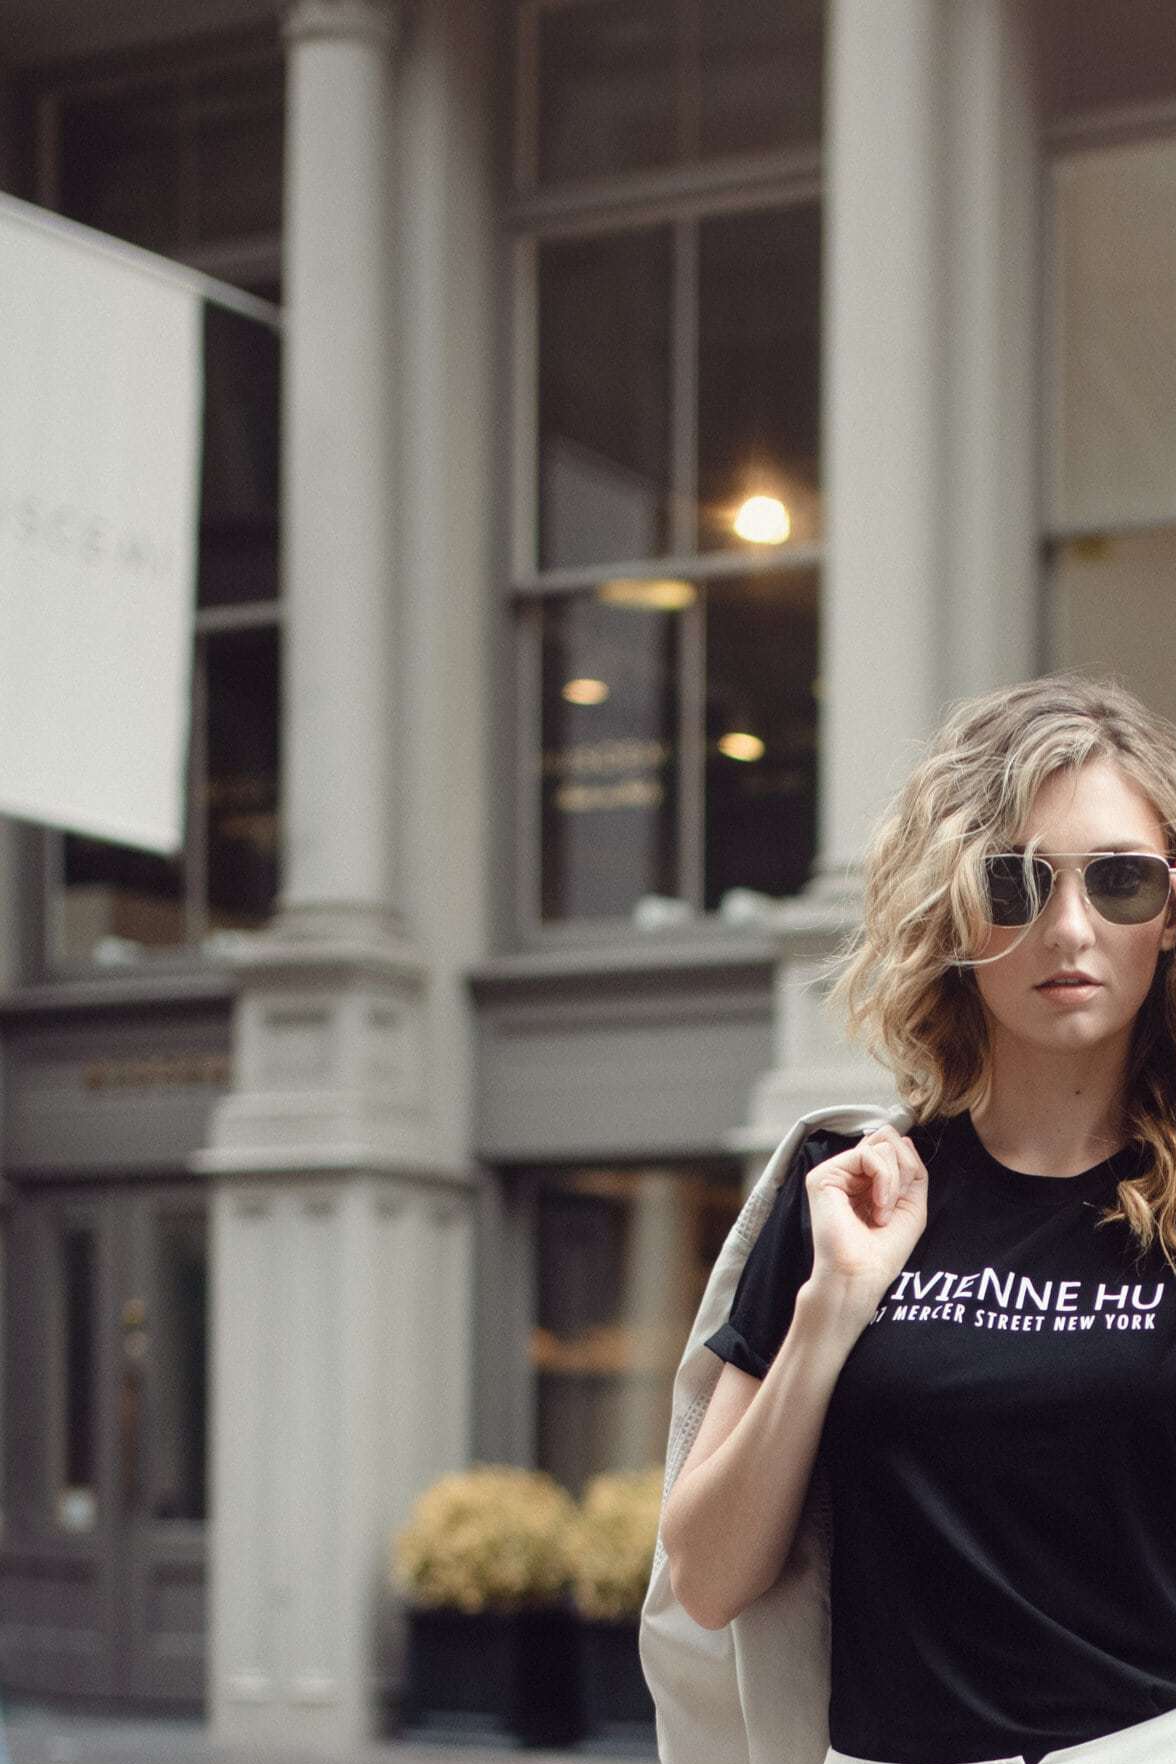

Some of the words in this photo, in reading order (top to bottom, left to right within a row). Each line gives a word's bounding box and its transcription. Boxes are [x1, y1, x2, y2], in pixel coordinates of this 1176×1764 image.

[890, 1267, 1081, 1312] IVIENNE
[1094, 1282, 1165, 1311] HU
[892, 1302, 966, 1324] MERCER
[974, 1309, 1046, 1332] STREET
[1053, 1314, 1096, 1332] NEW
[1104, 1312, 1156, 1331] YORK
